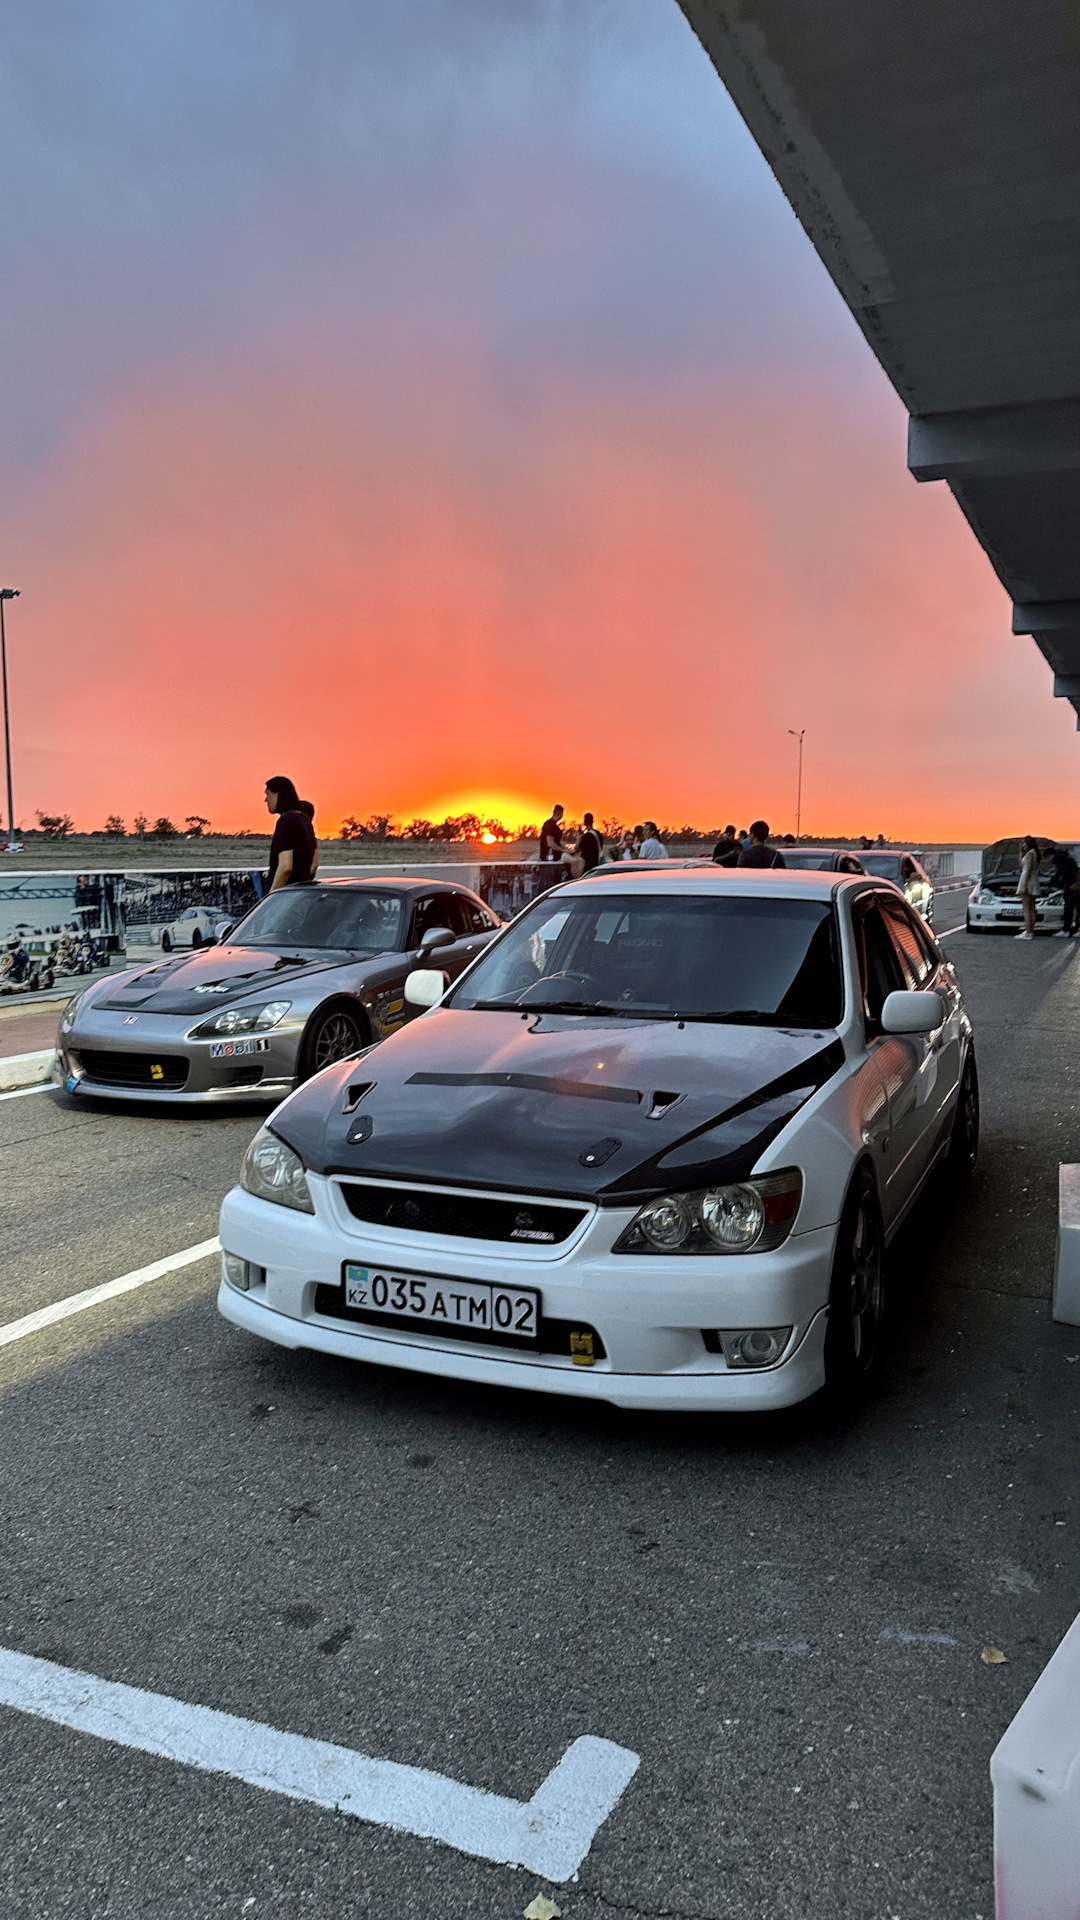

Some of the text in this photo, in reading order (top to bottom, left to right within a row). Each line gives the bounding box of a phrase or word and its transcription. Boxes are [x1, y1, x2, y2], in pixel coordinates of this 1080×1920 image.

[618, 937, 663, 948] RECARO
[211, 1040, 254, 1058] Mobil
[349, 1289, 367, 1305] KZ
[372, 1275, 534, 1331] 035 ATM 02
